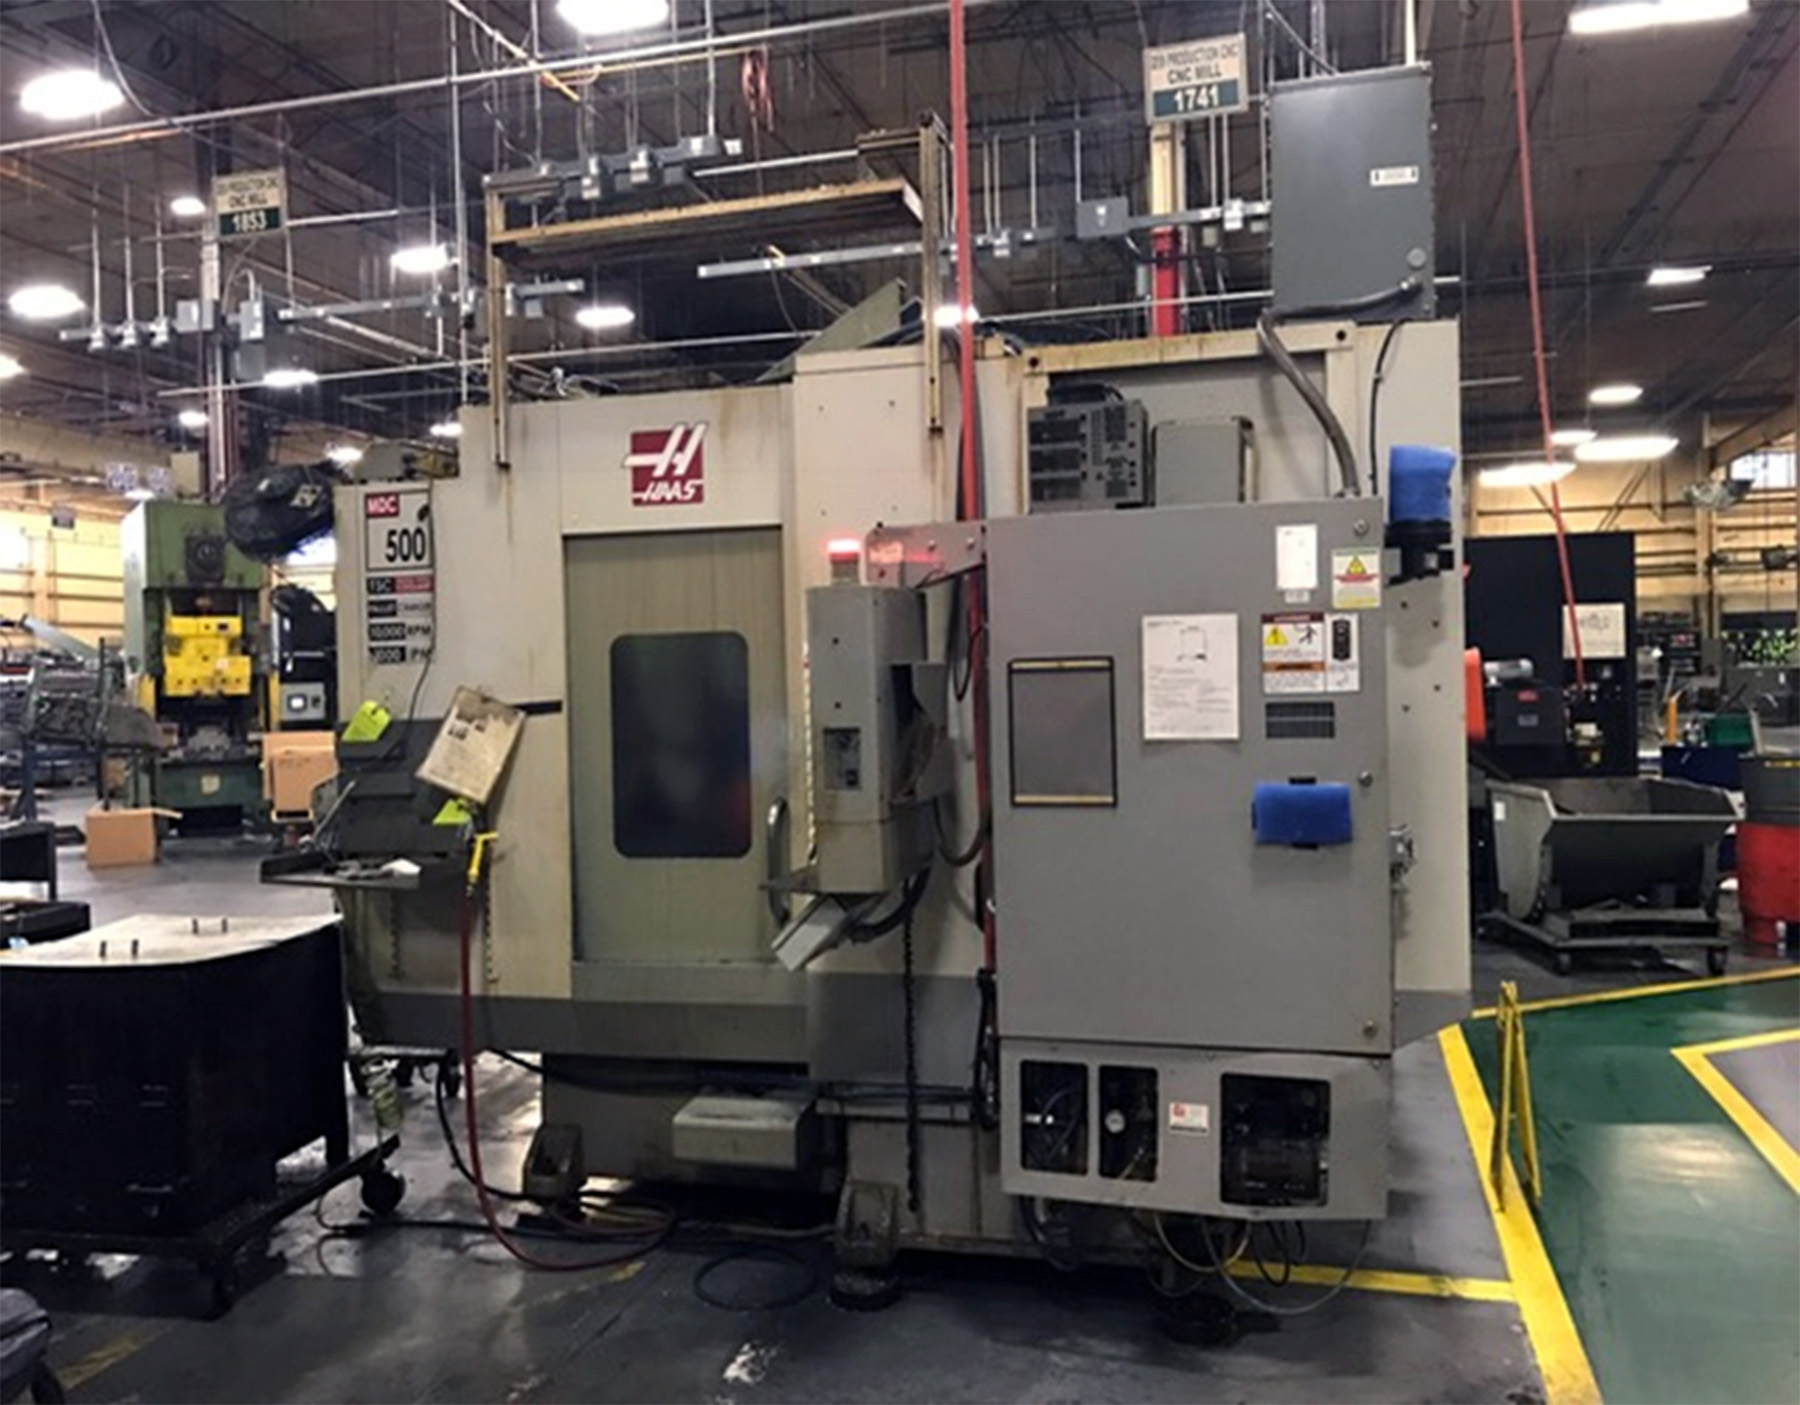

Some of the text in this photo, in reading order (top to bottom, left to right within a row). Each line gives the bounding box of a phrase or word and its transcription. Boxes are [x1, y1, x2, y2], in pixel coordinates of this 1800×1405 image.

[1166, 62, 1222, 85] CNC MILL
[1173, 84, 1219, 113] 1741
[631, 479, 704, 502] HAAS
[367, 495, 398, 515] MDC
[385, 527, 427, 563] 500
